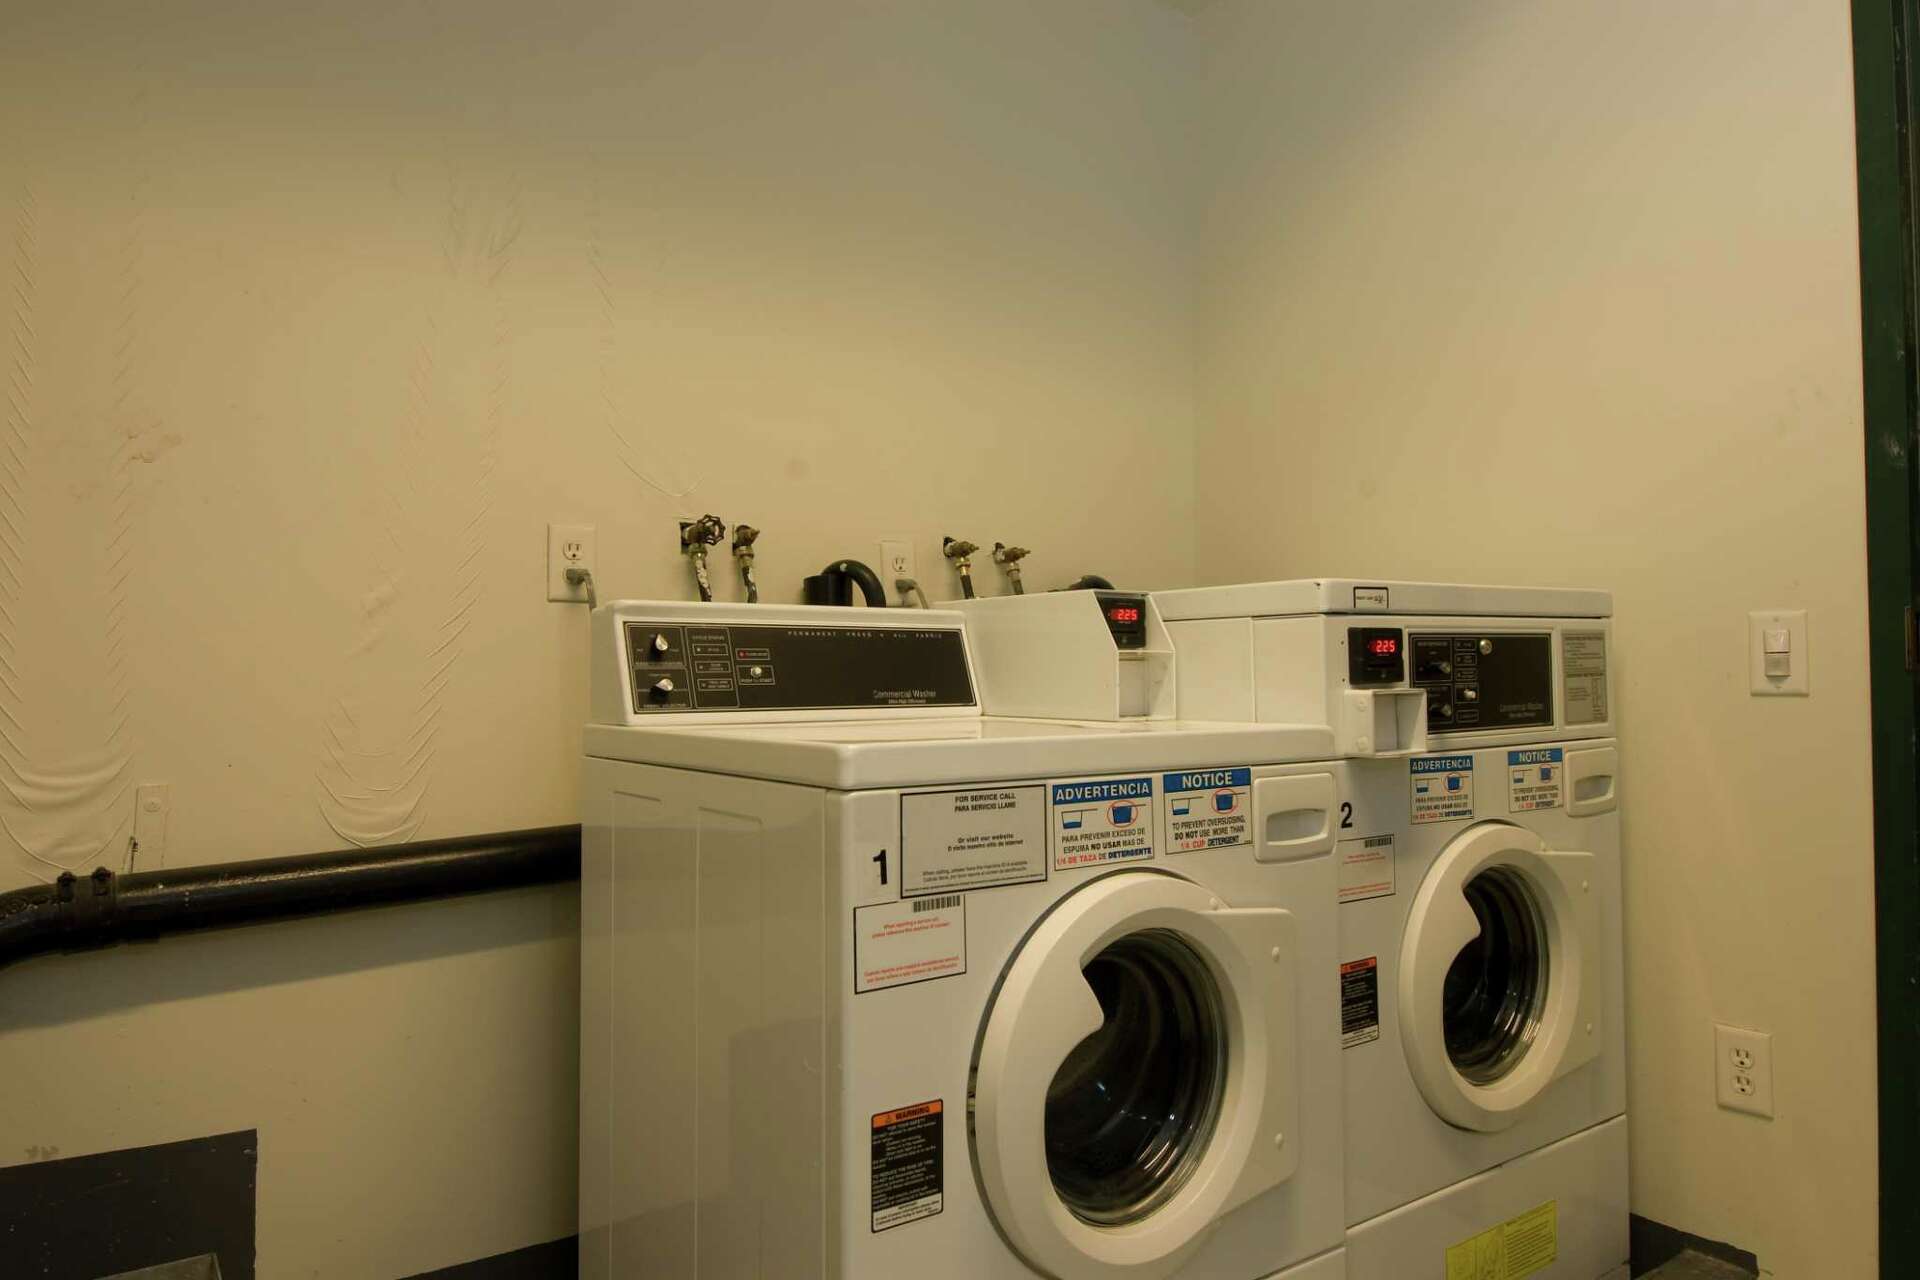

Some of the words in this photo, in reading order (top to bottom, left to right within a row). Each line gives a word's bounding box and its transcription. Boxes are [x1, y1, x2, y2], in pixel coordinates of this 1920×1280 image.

[912, 688, 936, 698] Washer
[1518, 750, 1551, 762] NOTICE
[1412, 758, 1471, 771] ADVERTENCIA
[1182, 771, 1232, 788] NOTICE
[954, 795, 969, 803] FOR
[970, 793, 998, 802] SERVICE
[999, 792, 1016, 800] CALL
[1056, 783, 1150, 801] ADVERTENCIA
[954, 804, 970, 813] PARA
[970, 803, 997, 812] SERVICIO
[998, 801, 1016, 810] LLAME
[1340, 801, 1353, 829] 2
[1172, 821, 1180, 830] TO
[1181, 819, 1206, 829] PREVENT
[1174, 831, 1184, 840] DO
[1185, 829, 1198, 839] NOT
[1199, 828, 1211, 838] USE
[1212, 826, 1229, 836] MORE
[1230, 824, 1245, 833] THAN
[1061, 834, 1079, 843] PARA
[1079, 831, 1110, 842] PREVENIR
[1137, 827, 1145, 836] DE
[1192, 838, 1206, 848] CUP
[1207, 835, 1239, 847] DETERGENT
[1063, 844, 1089, 854] ESPUMA
[1090, 843, 1101, 851] NO
[1102, 840, 1122, 849] USAR
[1136, 837, 1145, 845] DE
[1067, 855, 1077, 864] DE
[1079, 853, 1097, 862] TAZA
[1098, 851, 1107, 860] DE
[1108, 847, 1152, 860] DETERGENTE
[872, 848, 888, 885] 1
